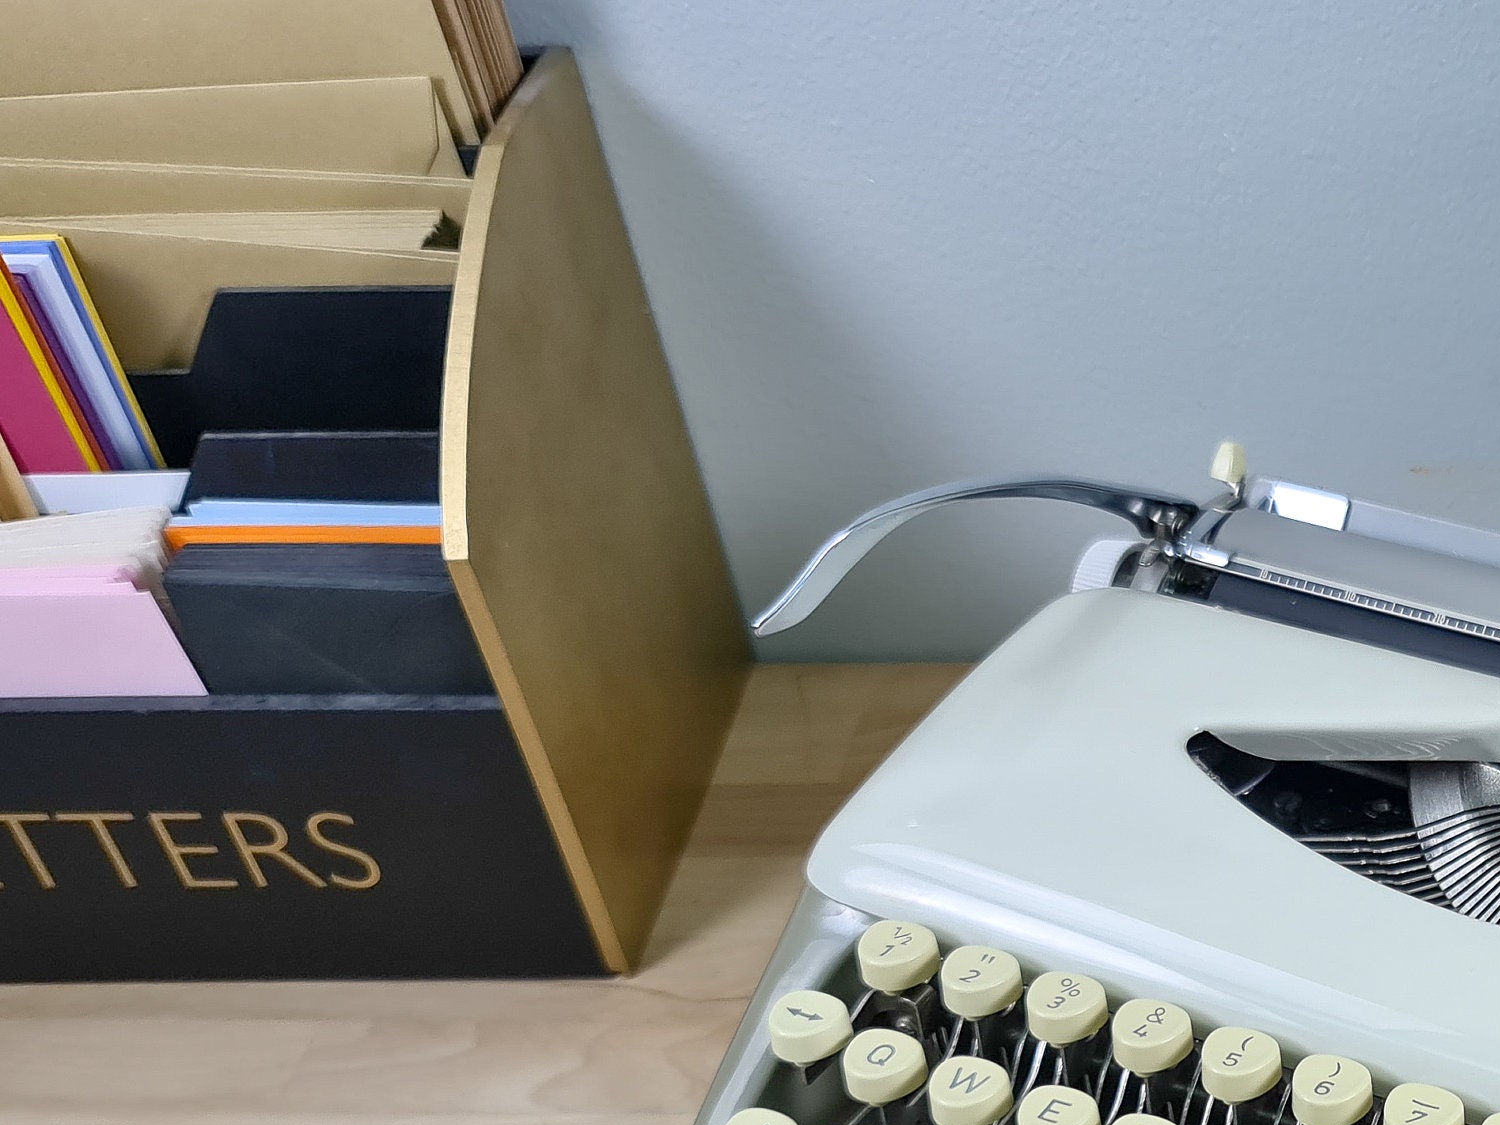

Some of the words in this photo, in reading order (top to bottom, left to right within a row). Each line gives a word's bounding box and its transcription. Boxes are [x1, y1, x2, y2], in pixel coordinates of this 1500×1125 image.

[0, 811, 381, 888] TTERS
[880, 944, 896, 958] 1
[958, 969, 981, 983] 2
[1060, 978, 1082, 998] %
[1046, 996, 1066, 1009] 3
[1146, 1007, 1167, 1026] &
[1132, 1024, 1149, 1039] 4
[866, 1044, 896, 1066] Q
[1222, 1052, 1241, 1068] 5
[948, 1067, 991, 1094] W
[1313, 1080, 1335, 1096] 6
[1037, 1098, 1072, 1124] E
[1405, 1110, 1427, 1125] 7
